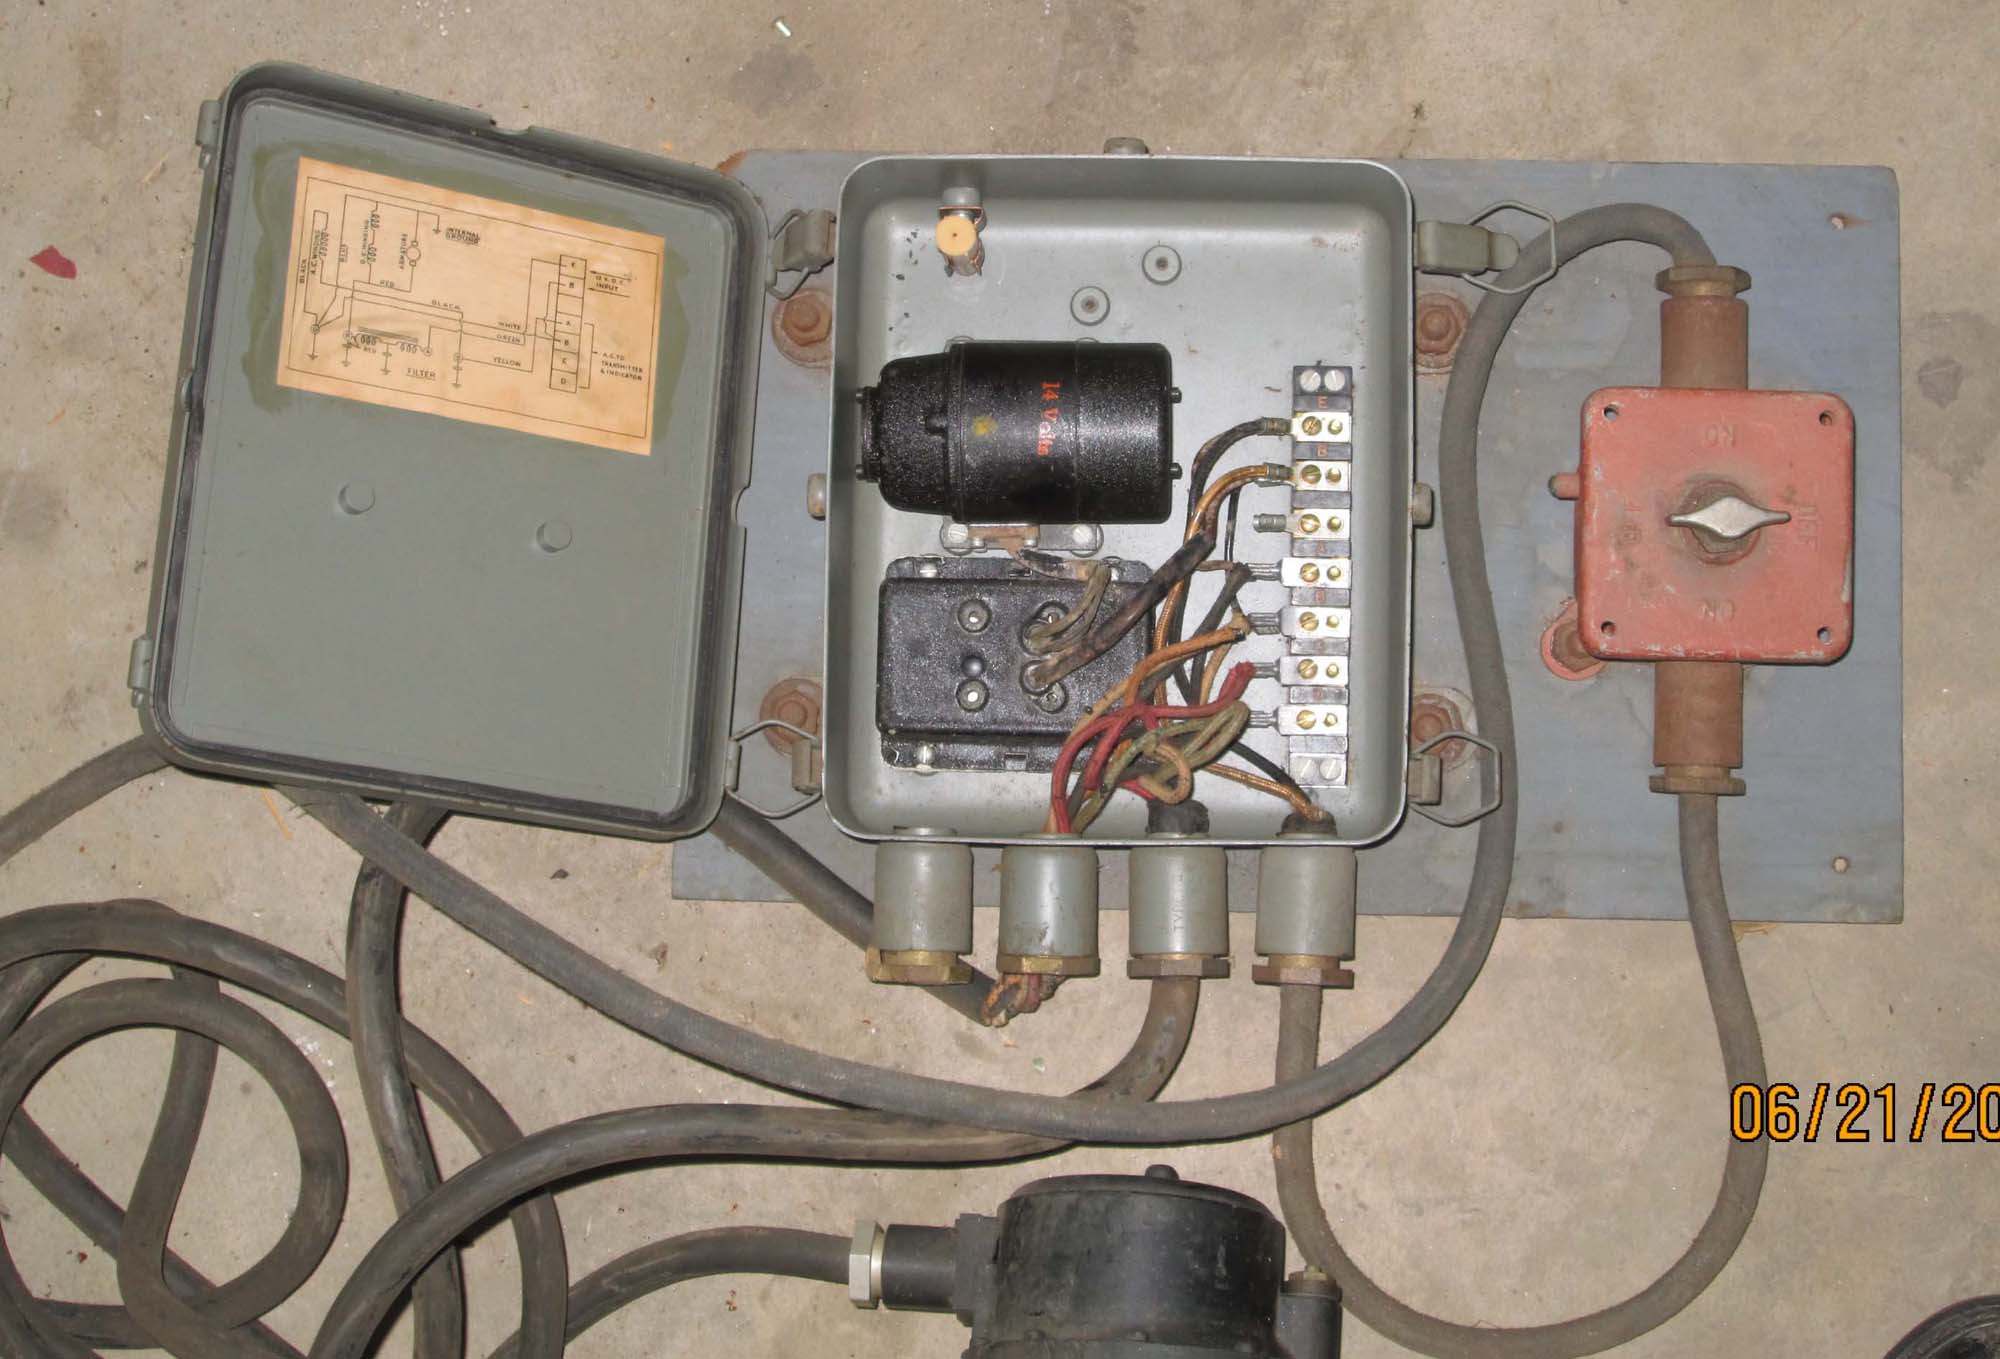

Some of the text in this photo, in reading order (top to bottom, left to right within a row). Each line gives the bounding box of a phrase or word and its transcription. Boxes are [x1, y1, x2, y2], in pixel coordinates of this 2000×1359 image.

[596, 282, 619, 292] INPUT
[431, 299, 461, 310] BLACK
[498, 320, 521, 330] WHITE
[496, 334, 521, 344] GREEN
[493, 356, 522, 368] YELLOW
[407, 366, 437, 378] FILTER
[1316, 394, 1329, 410] E
[1316, 443, 1329, 459] B
